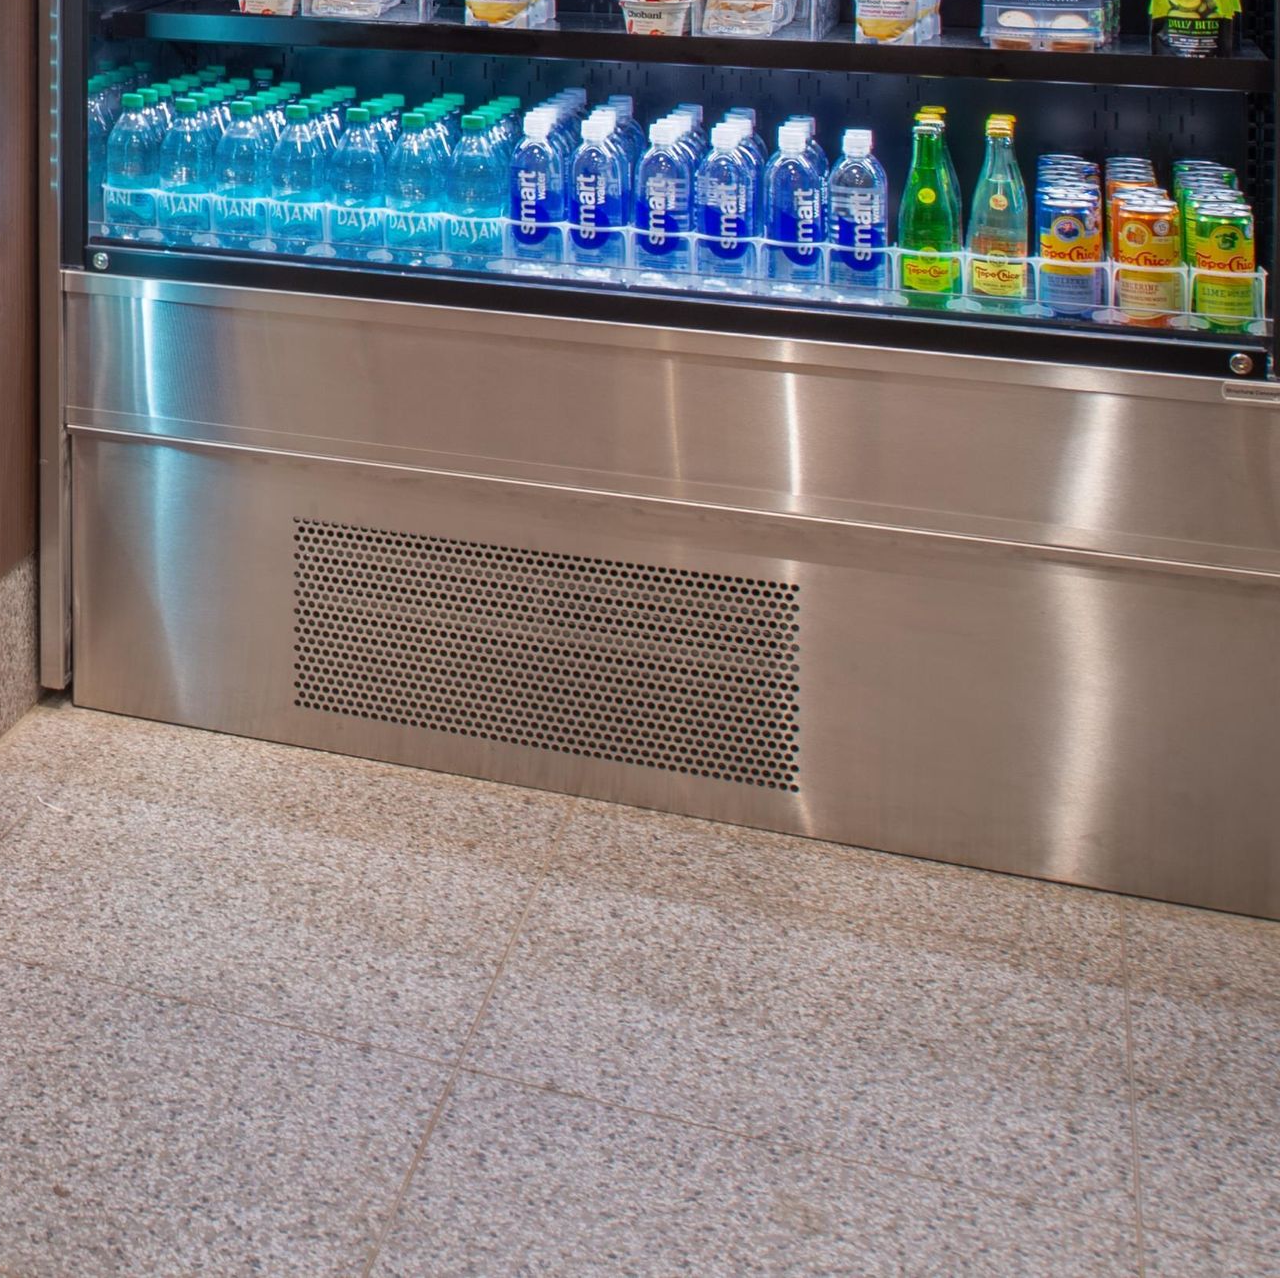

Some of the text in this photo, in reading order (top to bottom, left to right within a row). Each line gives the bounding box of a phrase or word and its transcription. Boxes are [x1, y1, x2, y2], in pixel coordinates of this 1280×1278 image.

[518, 170, 536, 235] smart
[577, 174, 596, 239] smart
[1202, 287, 1226, 297] LIME
